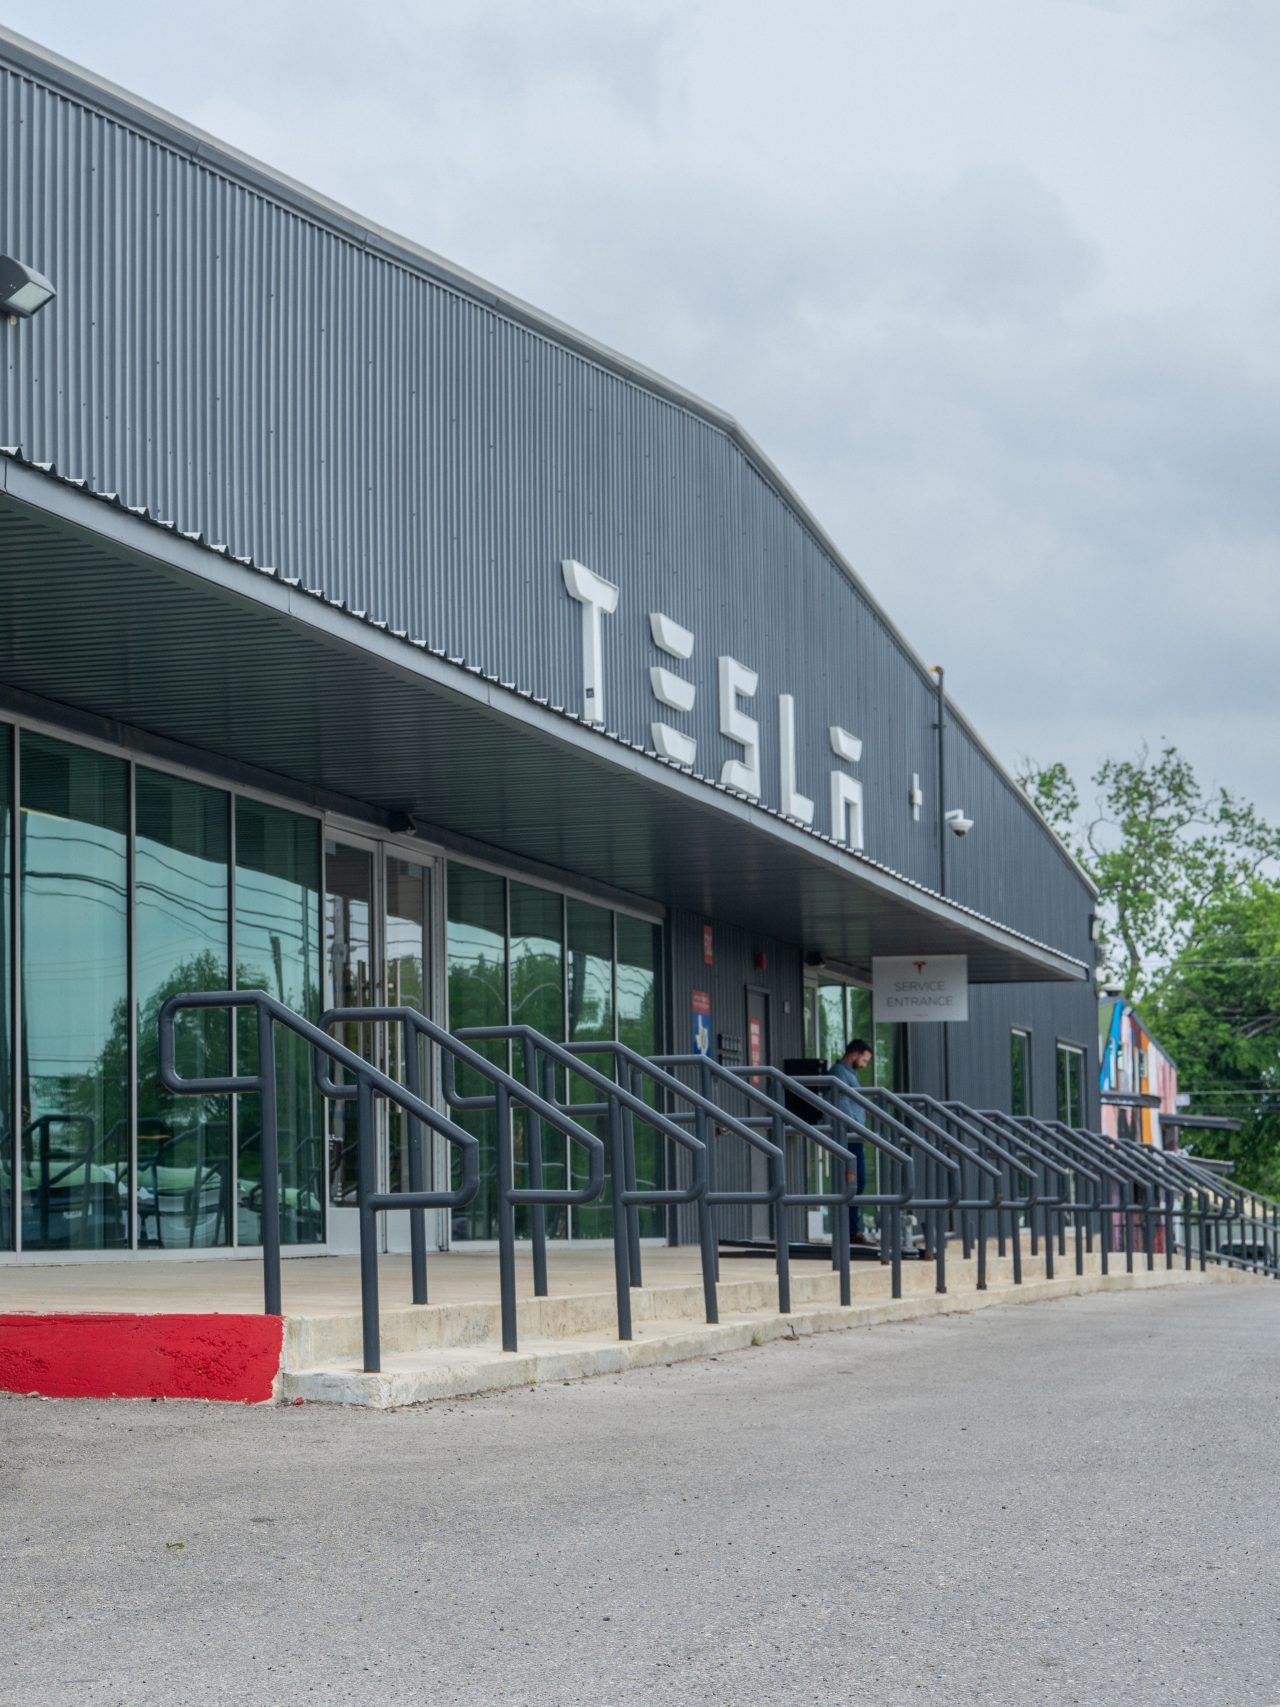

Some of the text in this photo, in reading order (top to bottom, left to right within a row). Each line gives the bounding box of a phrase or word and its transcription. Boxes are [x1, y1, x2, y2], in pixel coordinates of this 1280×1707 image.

[562, 559, 864, 850] TESLA
[894, 981, 945, 992] SERVICE
[886, 996, 953, 1007] ENTRANCE
